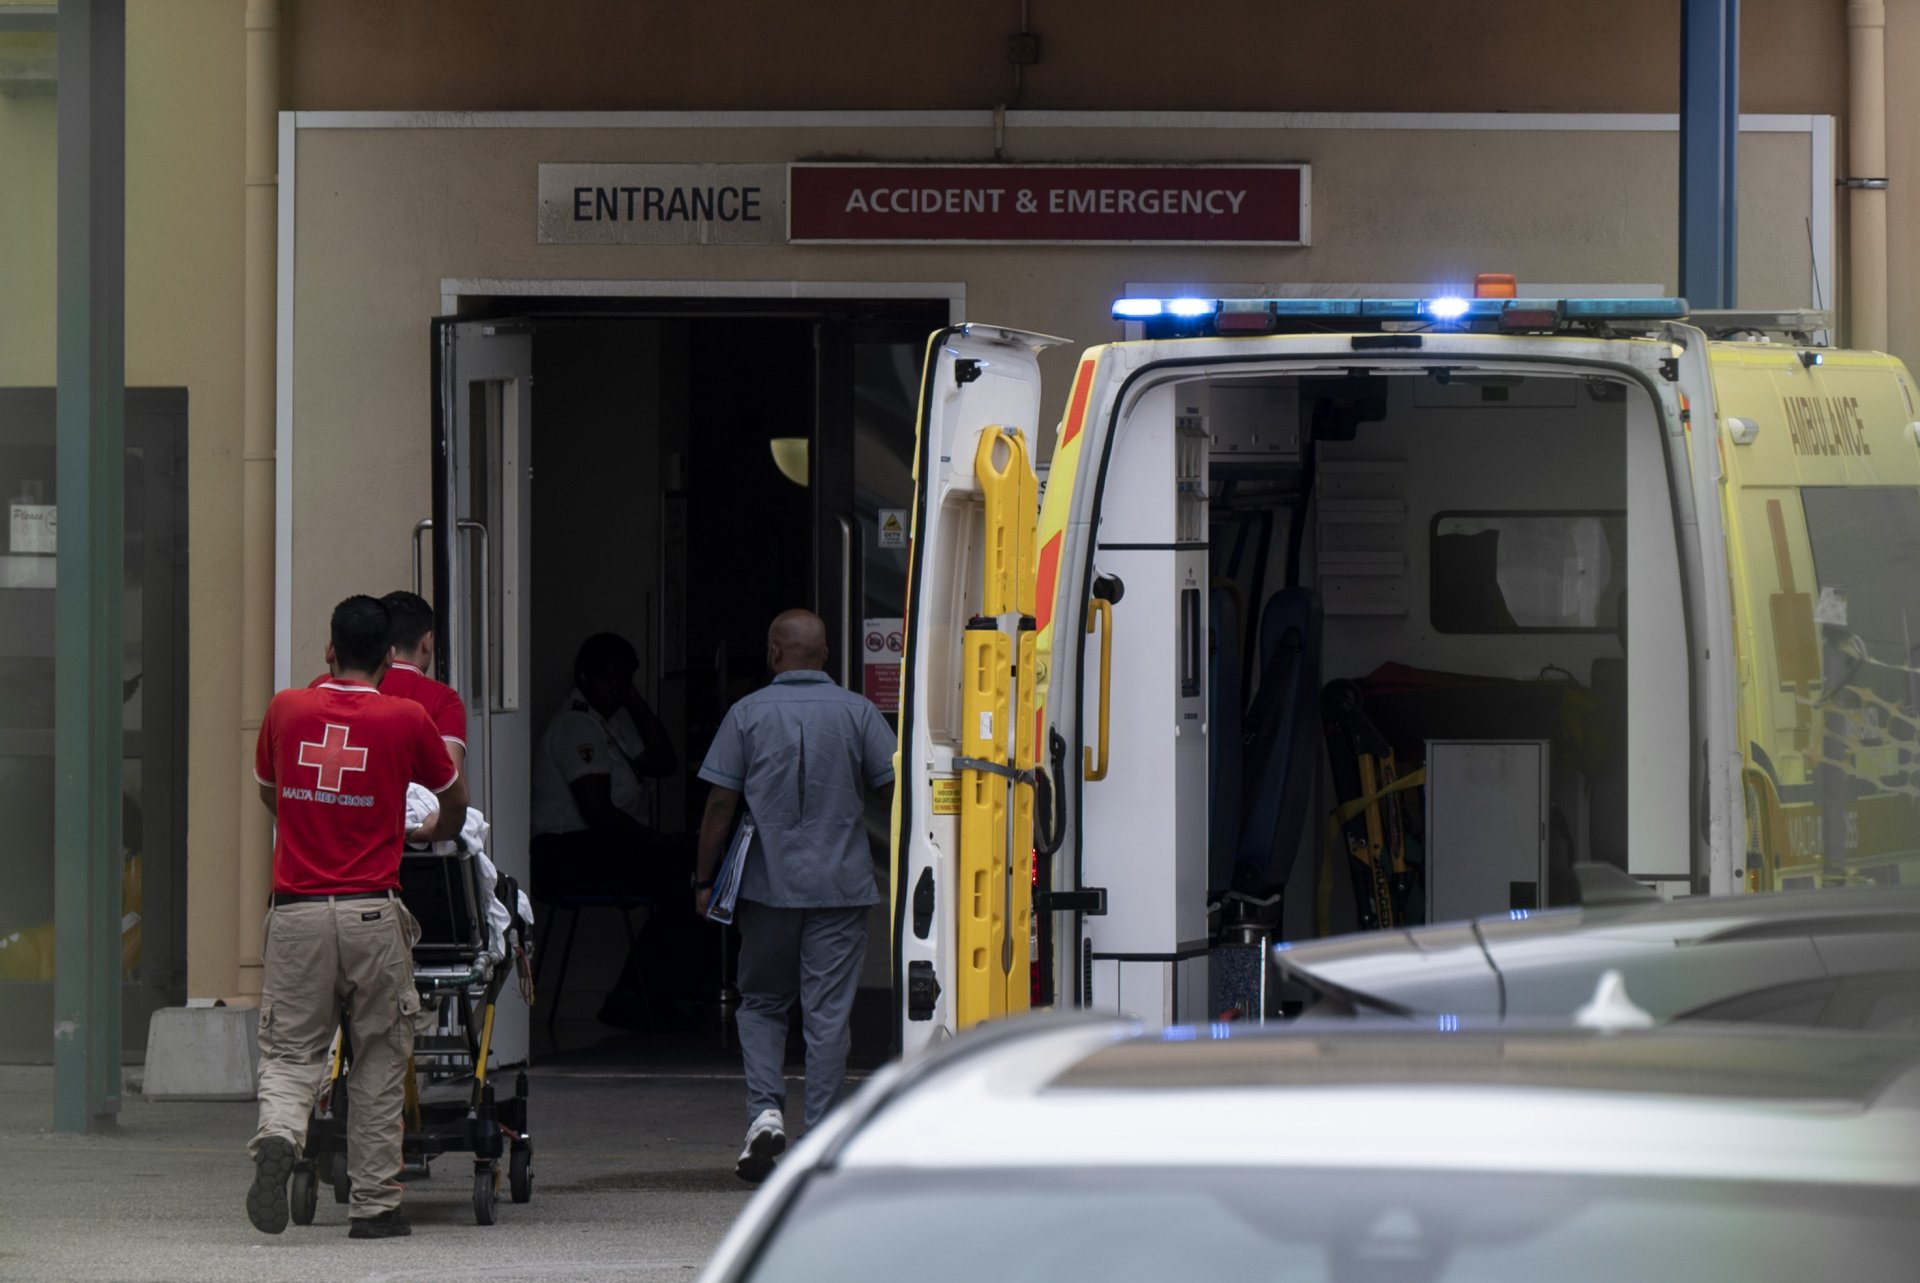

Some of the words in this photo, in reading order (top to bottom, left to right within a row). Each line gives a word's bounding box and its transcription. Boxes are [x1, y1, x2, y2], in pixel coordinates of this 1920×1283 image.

[574, 186, 762, 222] ENTRANCE
[845, 188, 1006, 213] ACCIDENT
[1015, 189, 1039, 213] &
[1049, 189, 1247, 214] EMERGENCY
[1783, 396, 1871, 457] AMBULANCE
[13, 508, 44, 521] Please
[283, 787, 312, 801] MALTA
[315, 791, 336, 803] RED
[338, 795, 374, 806] CROSS
